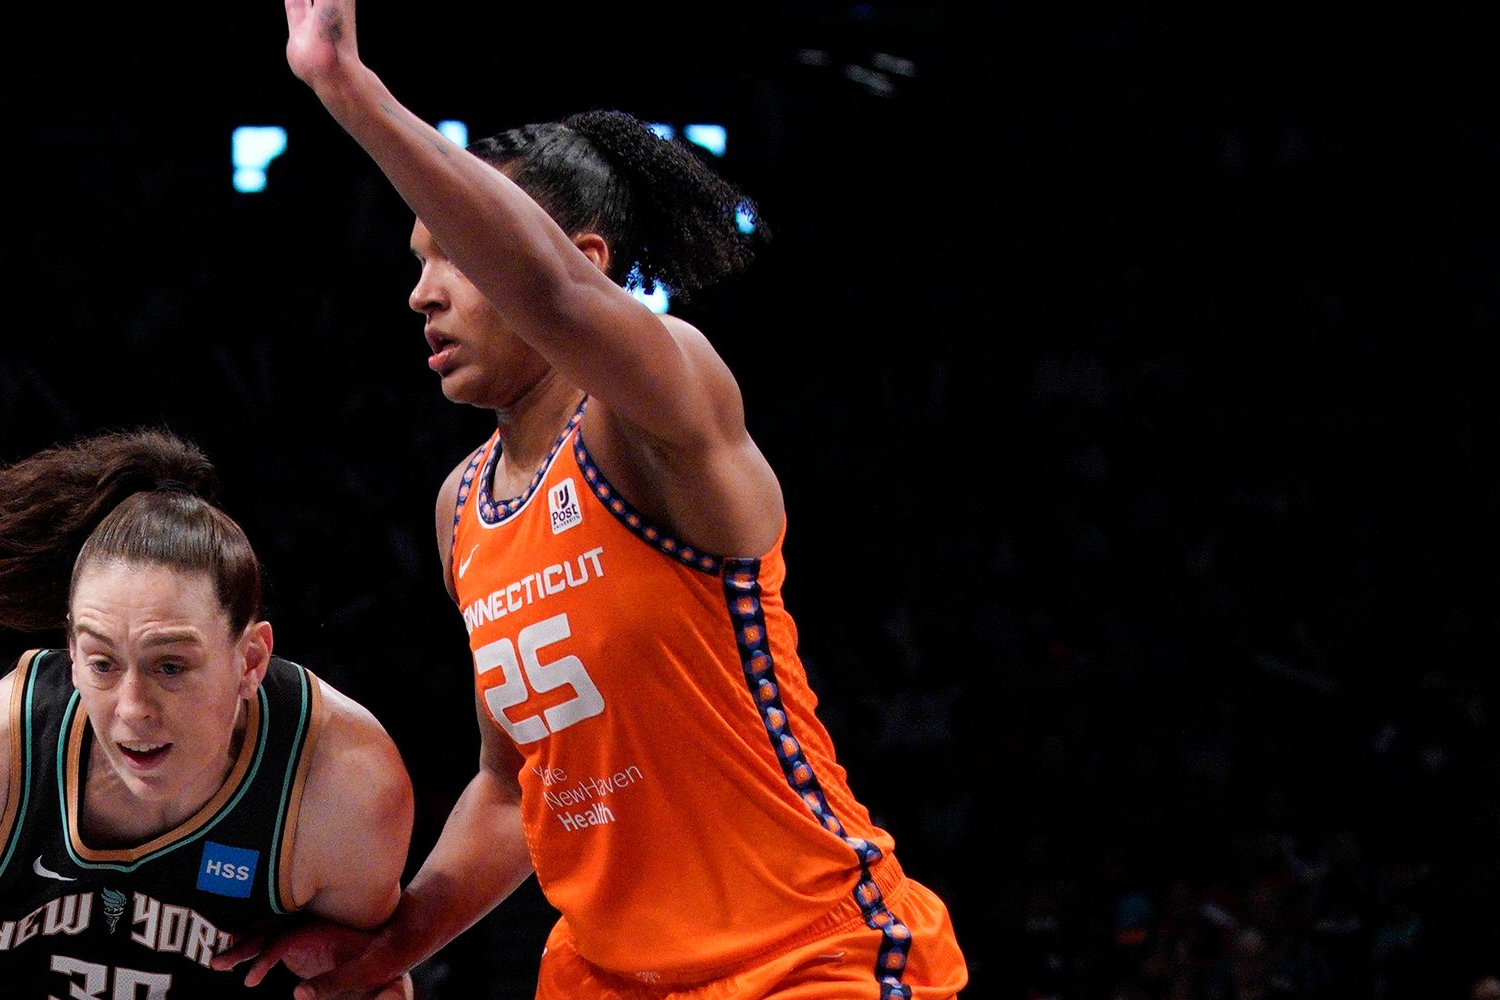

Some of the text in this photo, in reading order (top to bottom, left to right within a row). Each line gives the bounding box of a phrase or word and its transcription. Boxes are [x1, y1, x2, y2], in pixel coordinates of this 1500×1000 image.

[552, 502, 578, 525] Post
[463, 546, 604, 635] ONNECTICUT
[474, 612, 605, 745] 25
[532, 764, 568, 787] Yale
[556, 801, 616, 832] Health
[206, 858, 250, 881] HSS
